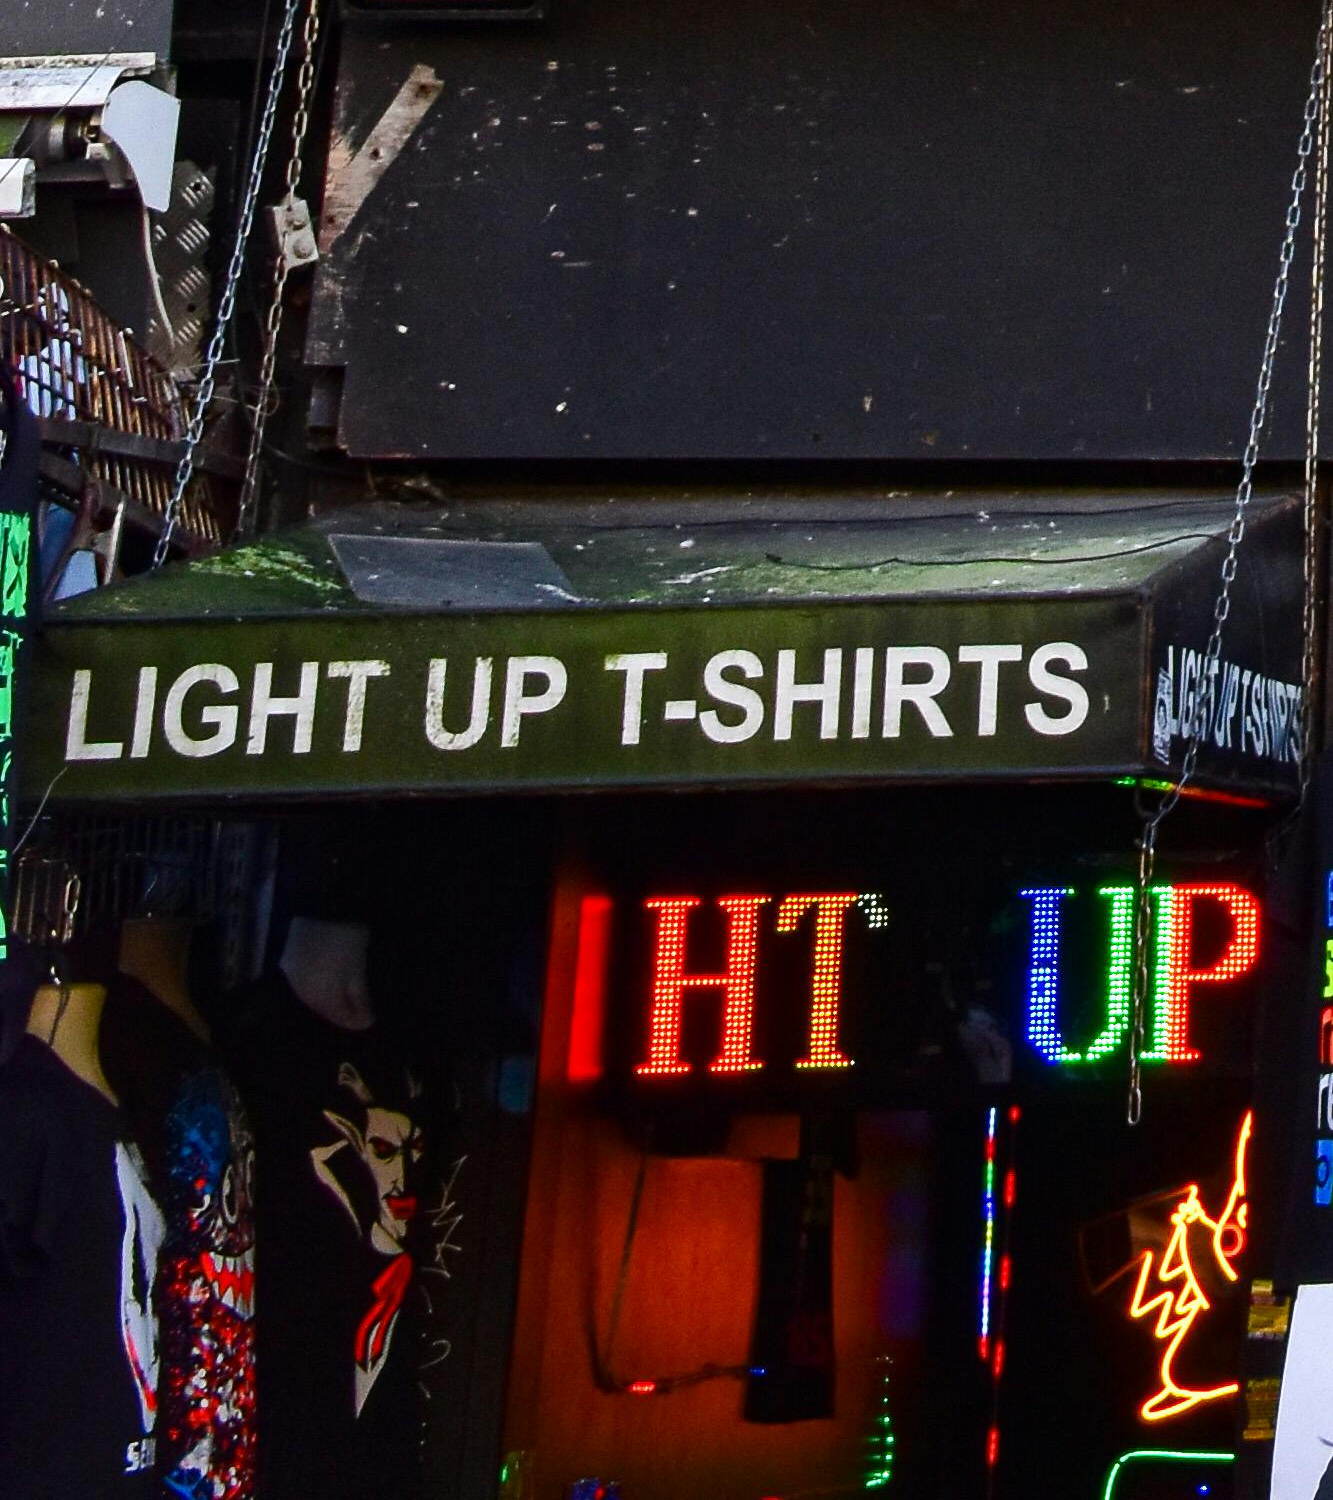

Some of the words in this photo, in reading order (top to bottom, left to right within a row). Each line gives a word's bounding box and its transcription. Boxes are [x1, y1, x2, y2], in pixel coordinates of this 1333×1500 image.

[65, 660, 391, 761] LIGHT
[425, 655, 568, 751] UP
[604, 641, 1090, 746] T-SHIRTS
[1168, 645, 1219, 742] LIGHT
[1214, 661, 1240, 748] UP
[1020, 884, 1263, 1063] UP
